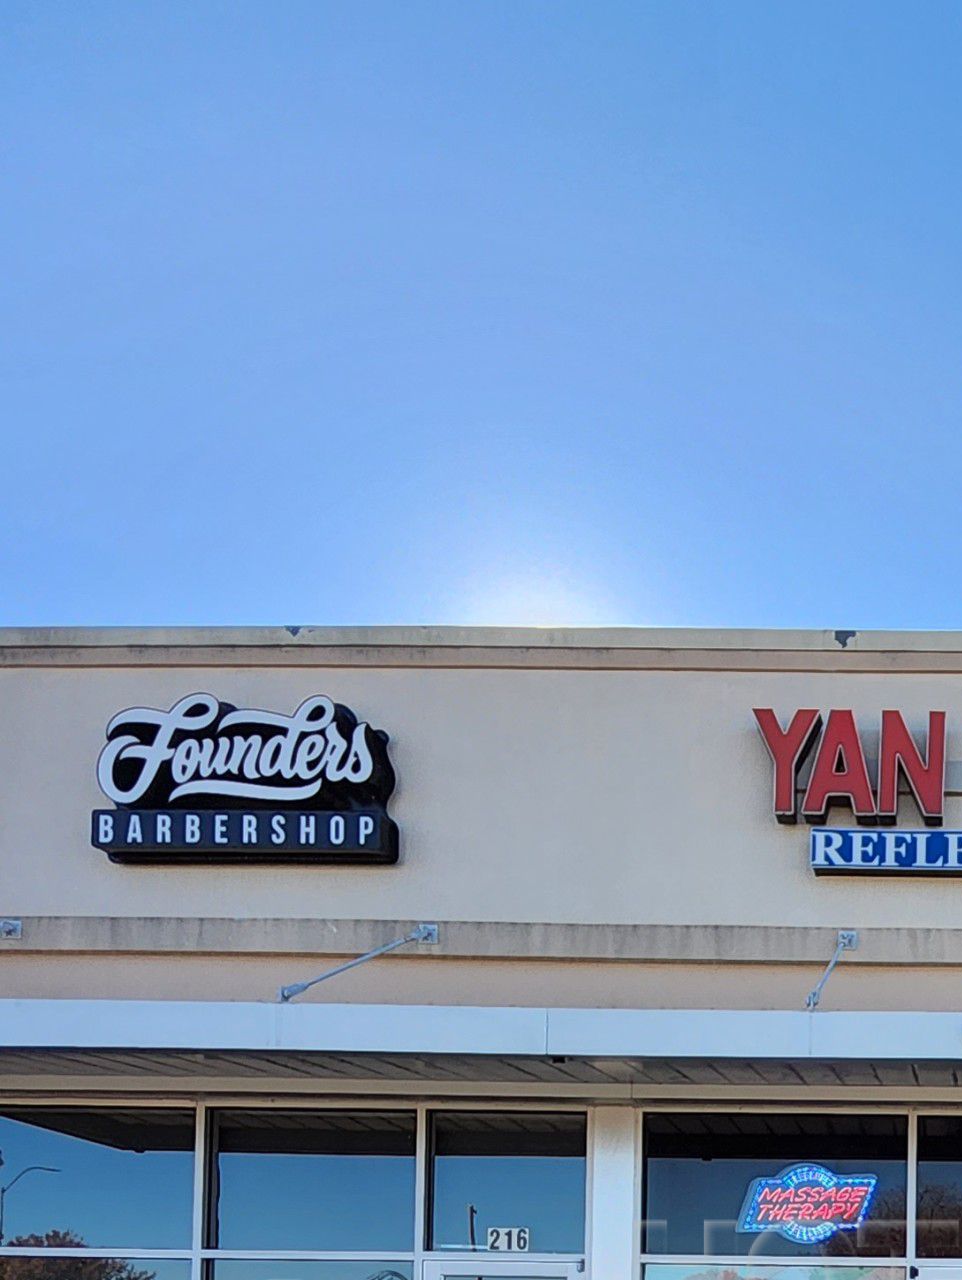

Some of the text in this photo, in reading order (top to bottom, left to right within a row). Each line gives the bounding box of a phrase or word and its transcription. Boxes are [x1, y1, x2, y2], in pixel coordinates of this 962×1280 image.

[97, 692, 374, 804] Founders
[752, 708, 946, 820] YAN
[98, 814, 374, 845] BARBERSHOP
[757, 1186, 868, 1202] MASSAGE
[757, 1203, 859, 1221] THERAPY
[490, 1228, 528, 1250] 216
